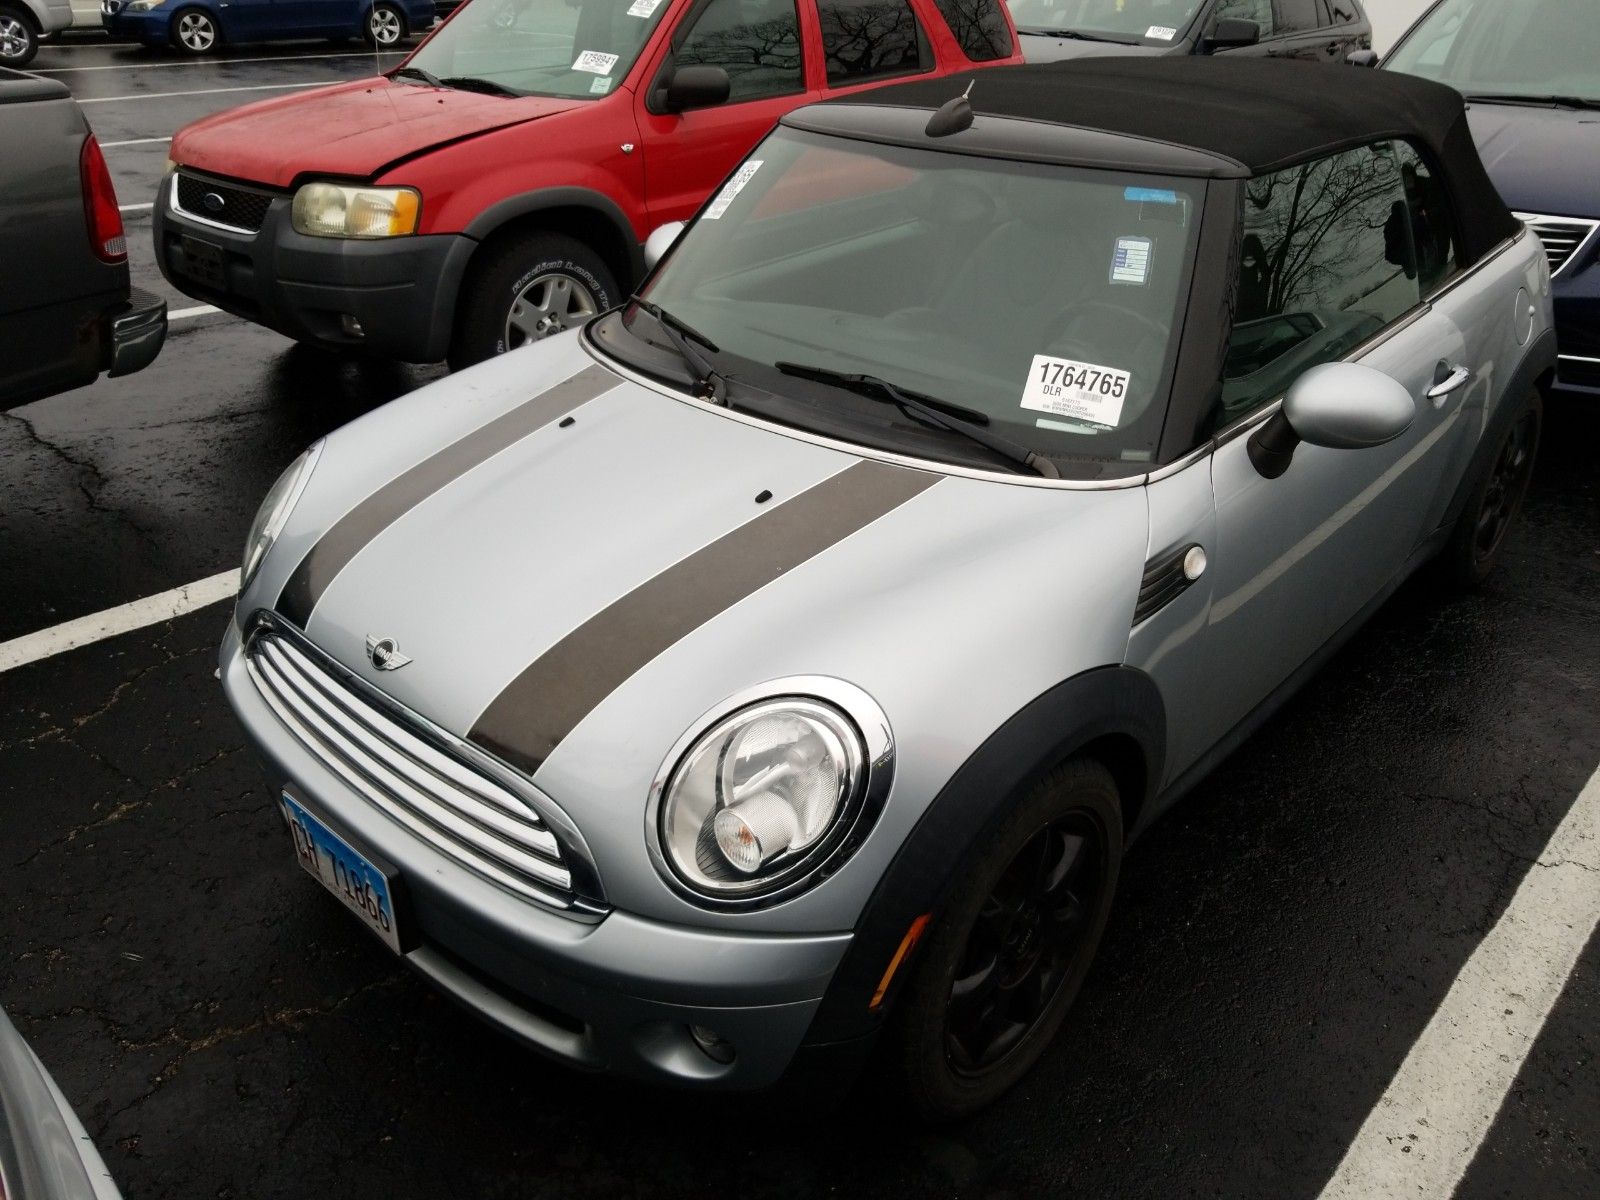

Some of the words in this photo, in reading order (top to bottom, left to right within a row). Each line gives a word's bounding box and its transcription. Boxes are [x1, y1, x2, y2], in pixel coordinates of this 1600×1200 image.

[583, 53, 616, 65] 1759941
[512, 260, 563, 294] Radial
[565, 261, 600, 291] Long
[1040, 362, 1126, 398] 1764765
[1042, 384, 1062, 397] DLR
[375, 645, 391, 661] MINI
[290, 817, 320, 870] CH
[324, 847, 390, 932] 71866
